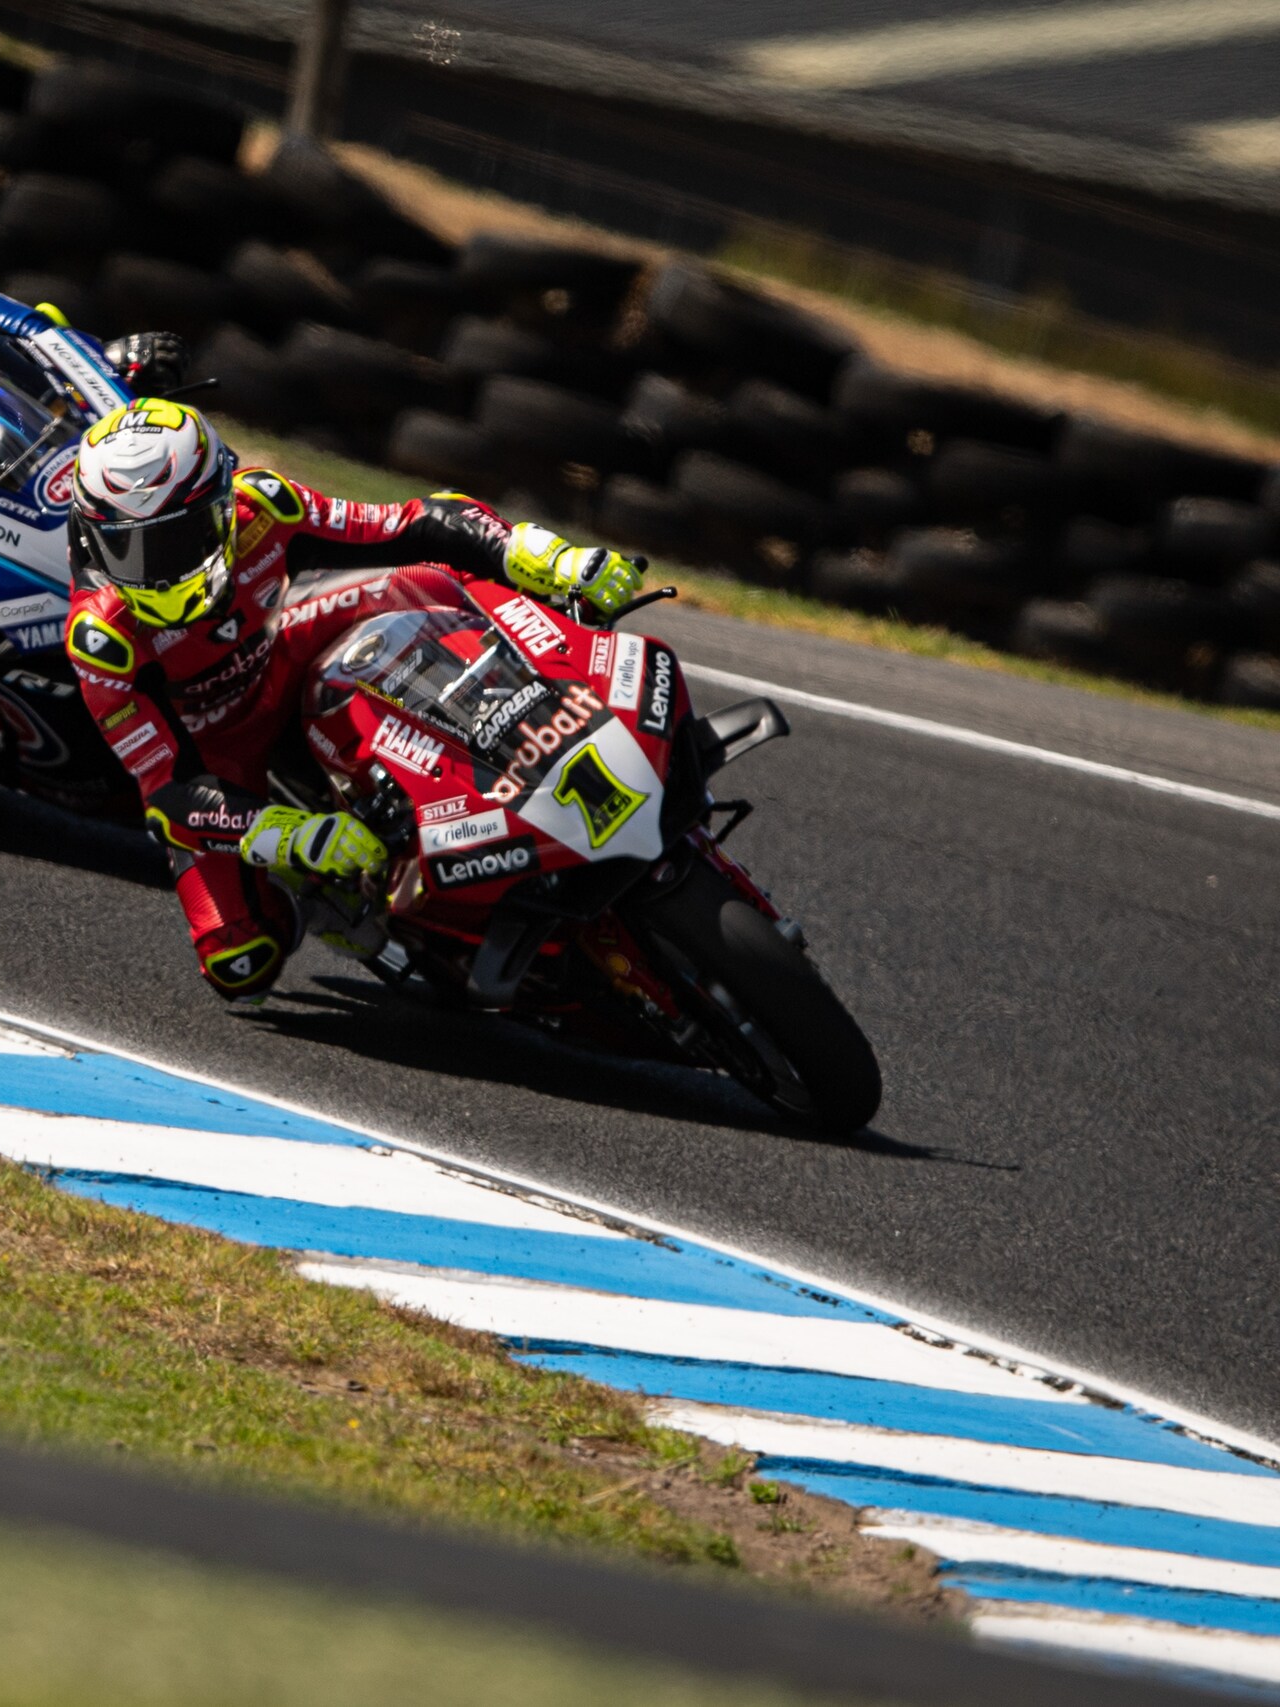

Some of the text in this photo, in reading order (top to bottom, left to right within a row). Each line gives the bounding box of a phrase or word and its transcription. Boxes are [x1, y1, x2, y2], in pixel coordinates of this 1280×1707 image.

[49, 341, 117, 411] OMETEON
[0, 601, 45, 618] Corpay
[493, 597, 560, 658] FIAMM
[17, 622, 67, 650] YAM
[594, 635, 611, 674] STULZ
[620, 658, 637, 689] riello
[644, 650, 671, 731] Lenovo
[477, 680, 548, 750] CARRERA
[374, 714, 444, 770] FIAMM
[491, 684, 605, 803] aruba.it
[423, 799, 468, 822] STULZ
[551, 742, 651, 850] 1
[444, 821, 499, 843] riello ups
[436, 847, 529, 884] Lenovo
